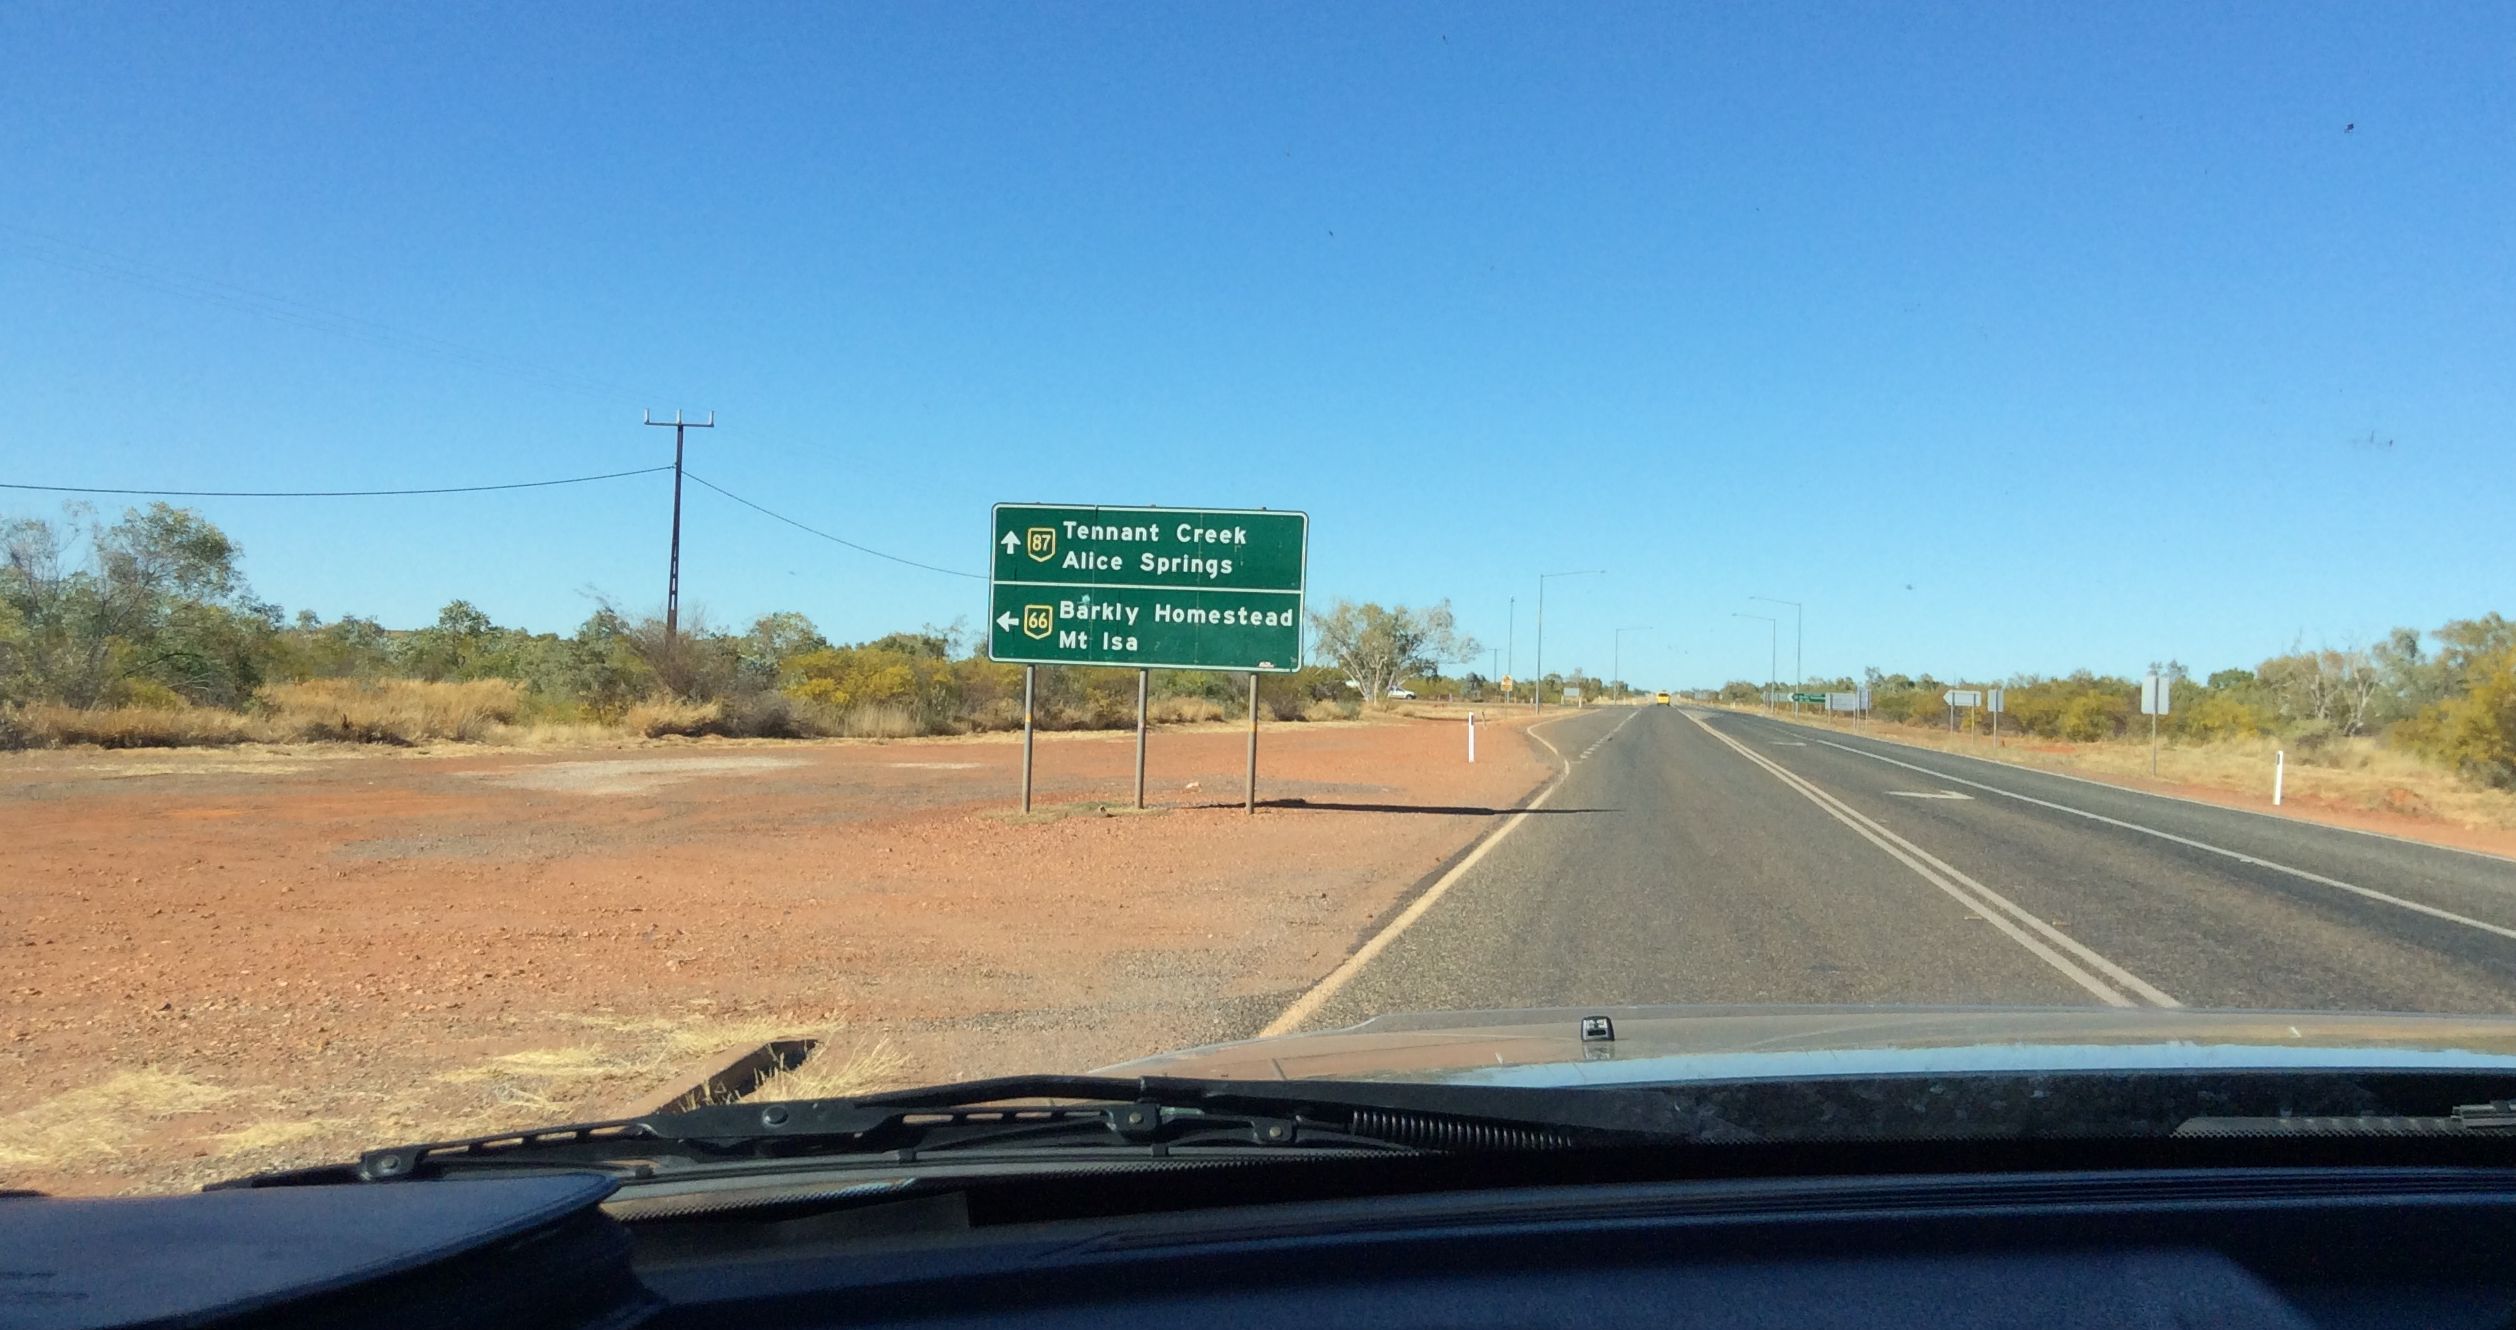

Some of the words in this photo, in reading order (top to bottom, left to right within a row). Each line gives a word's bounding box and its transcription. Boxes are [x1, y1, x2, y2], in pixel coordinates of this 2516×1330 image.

[1032, 534, 1051, 552] 87
[1062, 521, 1159, 542] Tennant
[1176, 523, 1247, 545] Creek
[1062, 551, 1123, 570] Alice
[1140, 553, 1233, 579] Springs
[1028, 612, 1048, 629] 66
[1059, 600, 1139, 625] Barkly
[1155, 603, 1293, 627] Homestead
[1059, 630, 1088, 650] Mt
[1103, 632, 1139, 652] Isa
